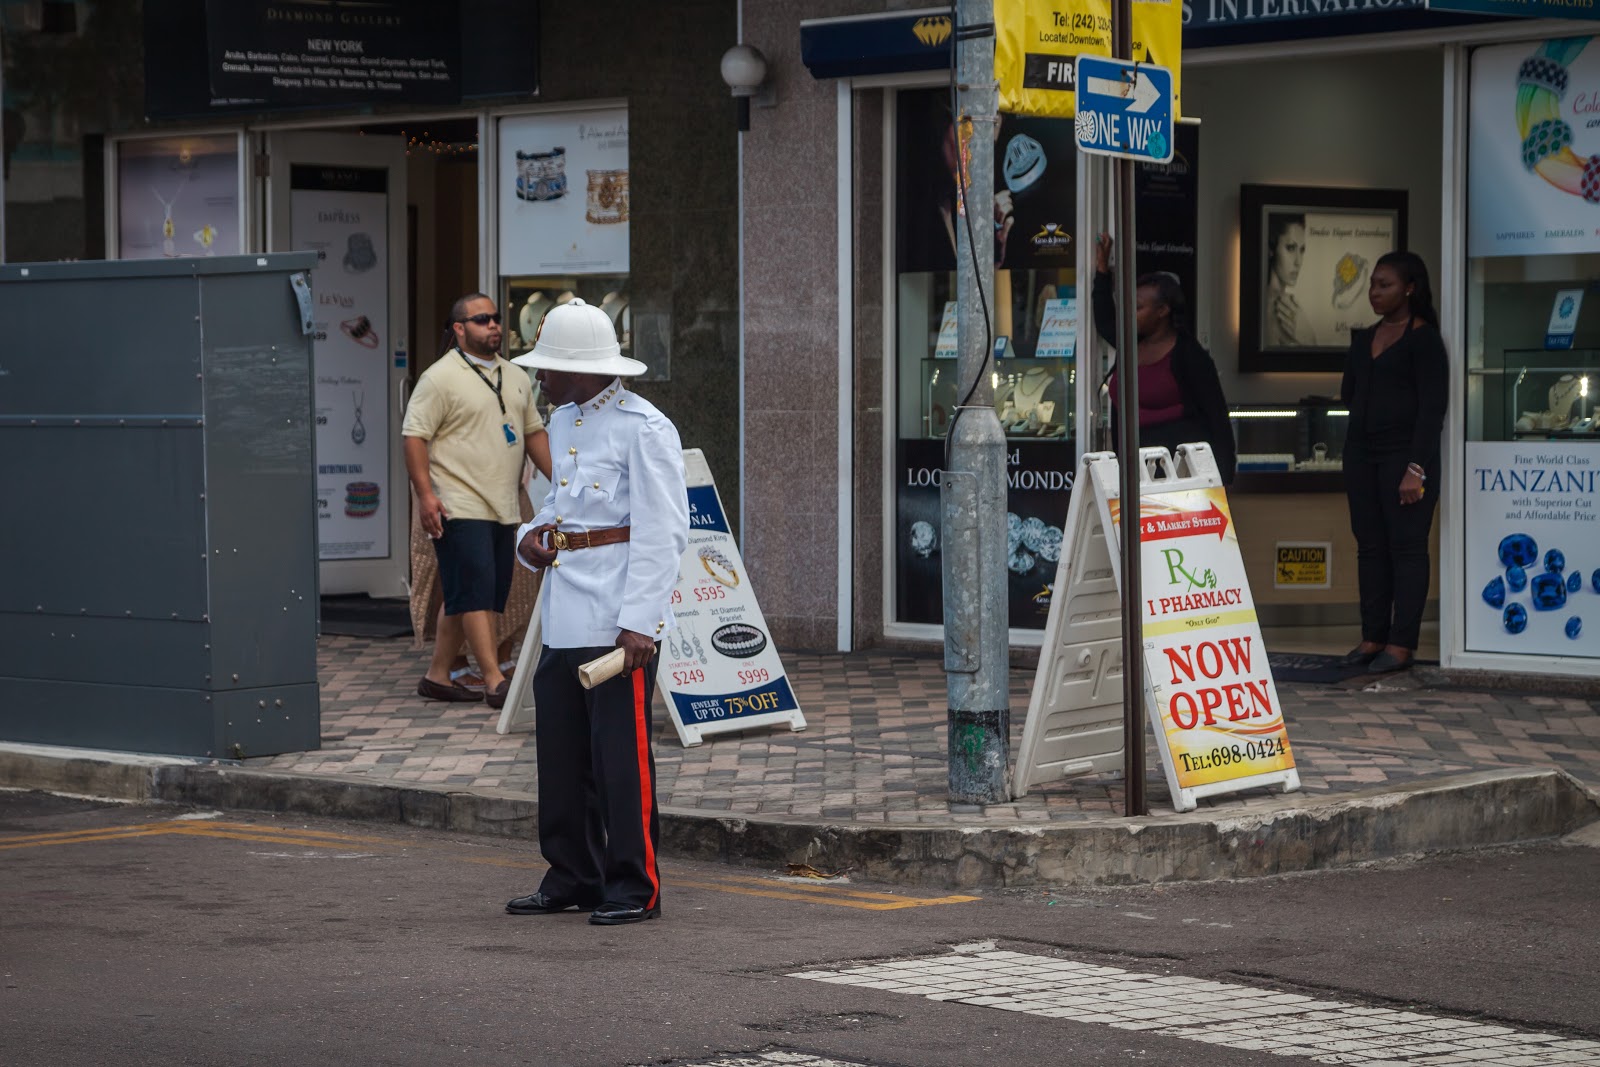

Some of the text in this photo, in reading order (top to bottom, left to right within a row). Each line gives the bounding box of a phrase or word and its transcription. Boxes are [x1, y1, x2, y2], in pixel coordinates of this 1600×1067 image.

[1052, 11, 1070, 27] Tel:
[1072, 13, 1096, 32] (242)
[307, 38, 364, 53] NEW YORK
[1039, 31, 1068, 43] Located
[1069, 32, 1106, 48] Downtown,
[1047, 61, 1075, 83] FIR
[1496, 230, 1535, 241] SAPPHIRES
[1545, 228, 1584, 239] EMERALDS
[1514, 454, 1590, 465] Fine World Class
[1512, 497, 1592, 509] with Superior Cut
[1505, 510, 1596, 521] and Affordable Price
[1147, 522, 1156, 533] &
[1156, 520, 1191, 532] MARKET
[1191, 516, 1222, 528] STREET
[713, 534, 728, 542] Ring
[1280, 548, 1324, 561] CAUTION
[693, 585, 726, 602] $595
[1159, 588, 1243, 615] PHARMACY
[674, 610, 700, 619] iamonds
[719, 605, 746, 614] Diamond
[719, 614, 743, 623] Bracelet
[668, 661, 692, 670] STARTING
[1163, 635, 1252, 685] NOW
[672, 669, 705, 686] $249
[737, 668, 769, 685] $999
[690, 698, 720, 711] JEWELRY
[693, 691, 779, 720] UP TO 75% OFF
[1169, 679, 1274, 730] OPEN
